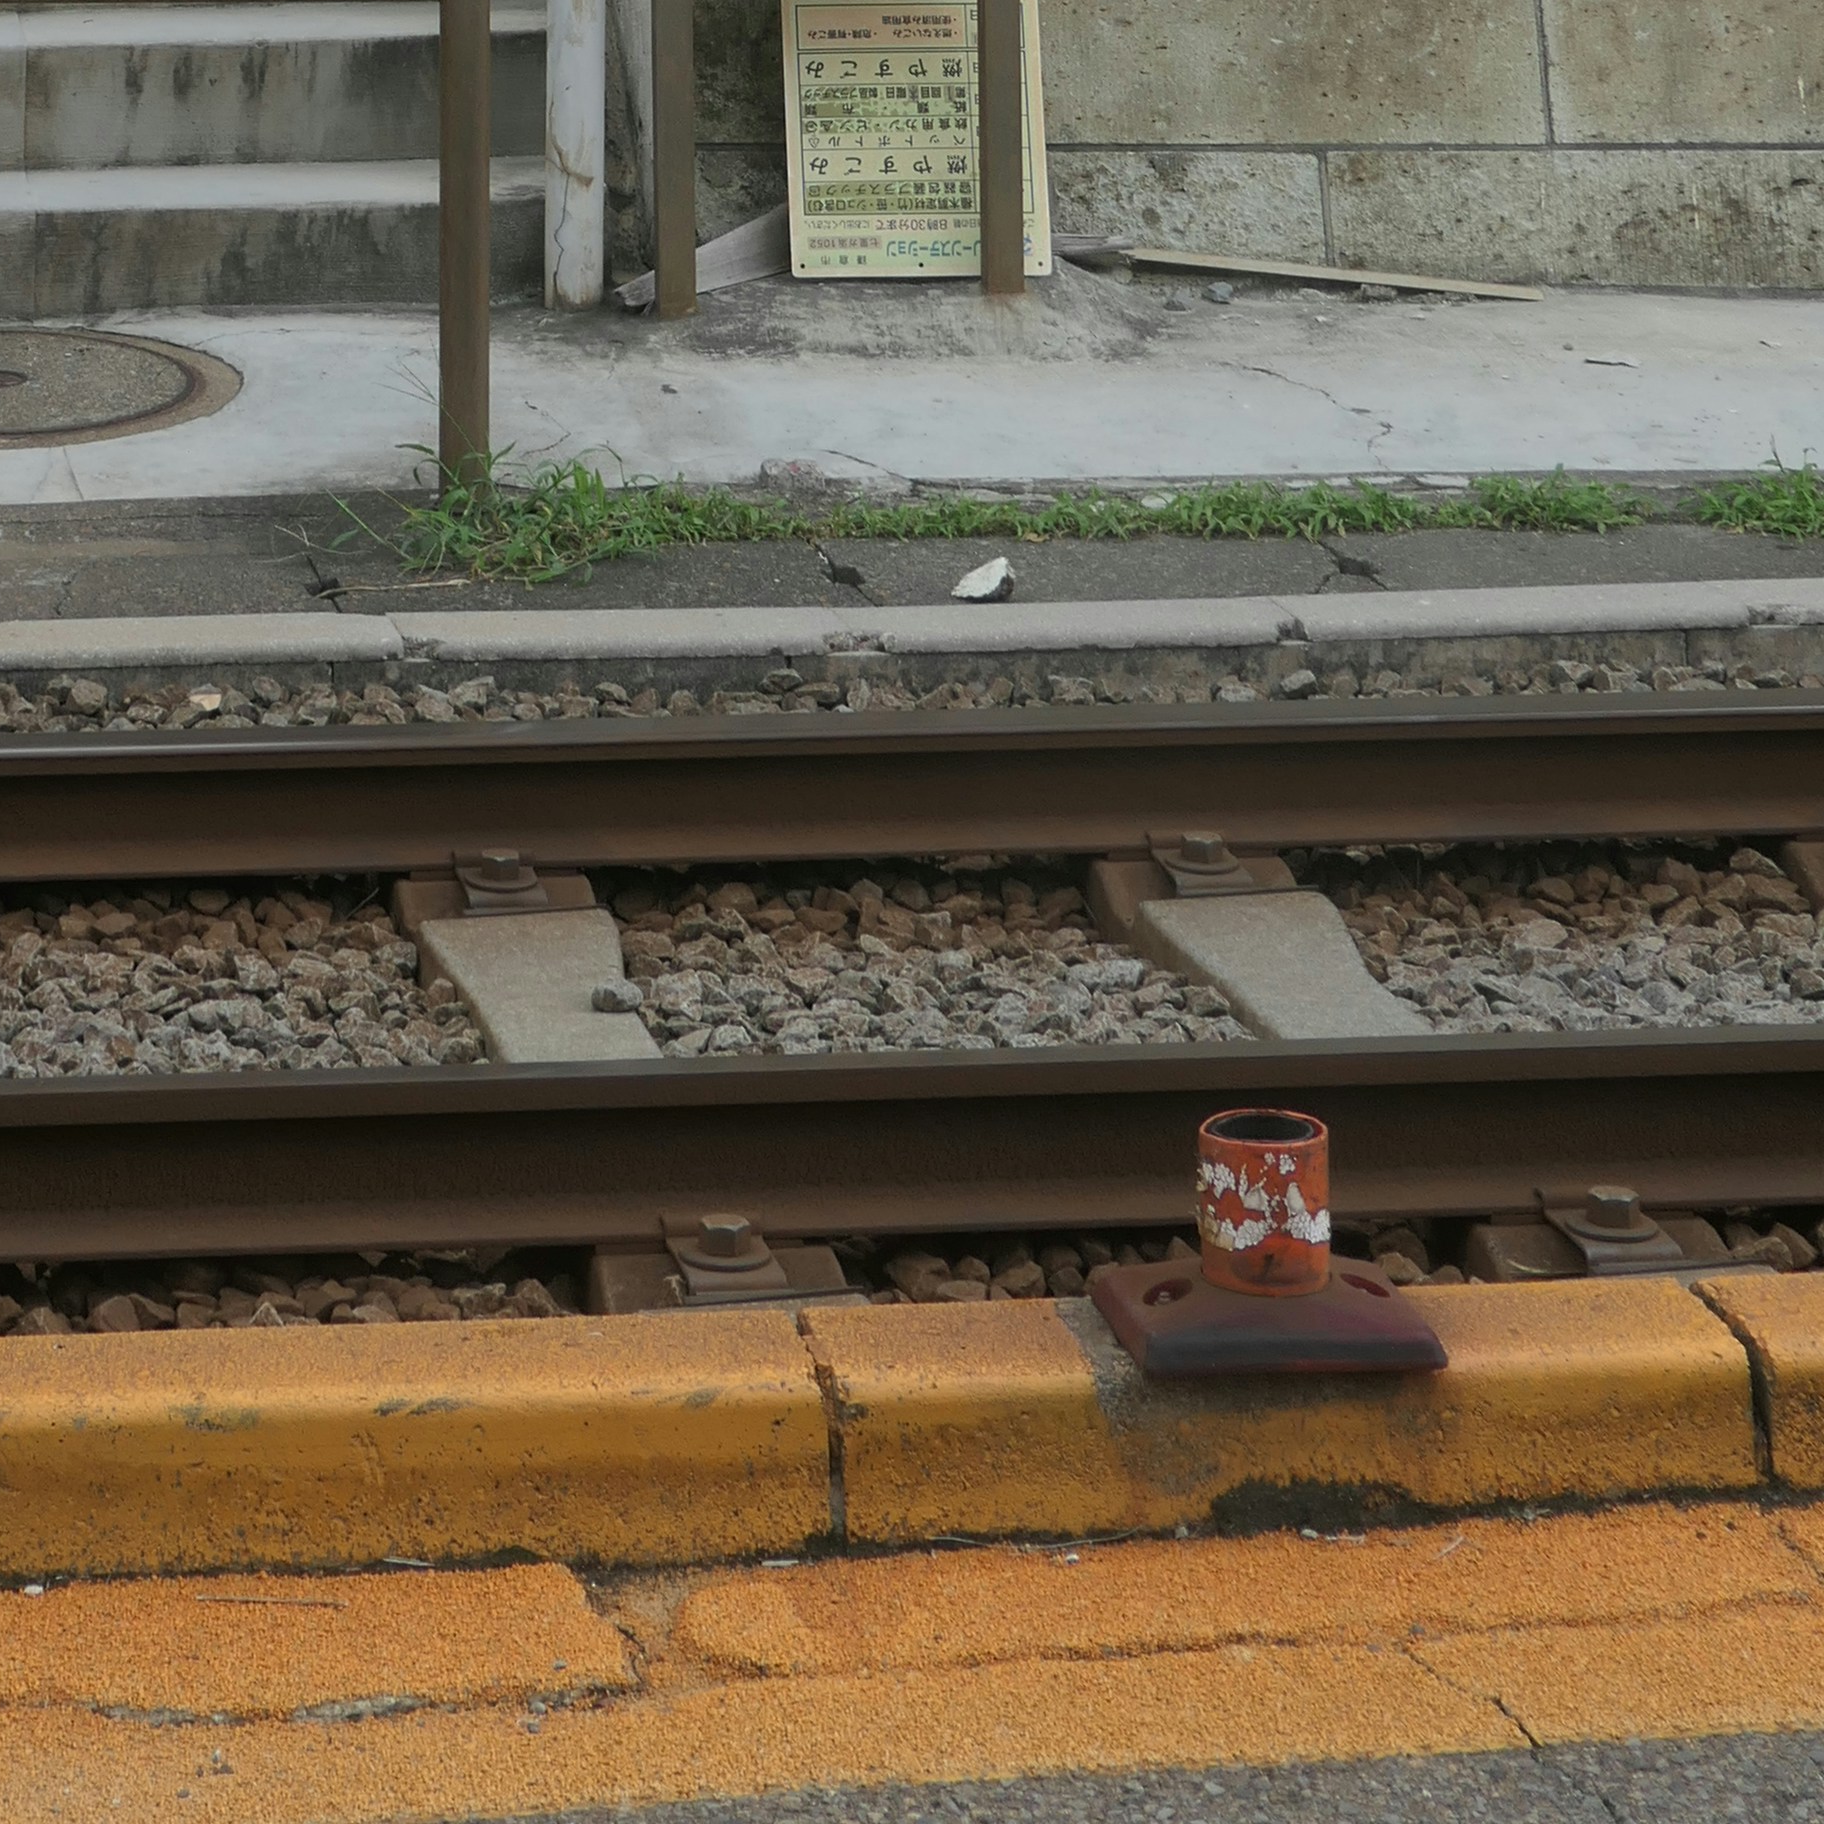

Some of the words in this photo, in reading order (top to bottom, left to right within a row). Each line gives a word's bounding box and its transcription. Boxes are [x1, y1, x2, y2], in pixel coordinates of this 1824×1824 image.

[806, 58, 962, 78] 燃やすごみ
[810, 154, 968, 174] 燃やすごみ
[874, 219, 948, 230] 8時30分まで
